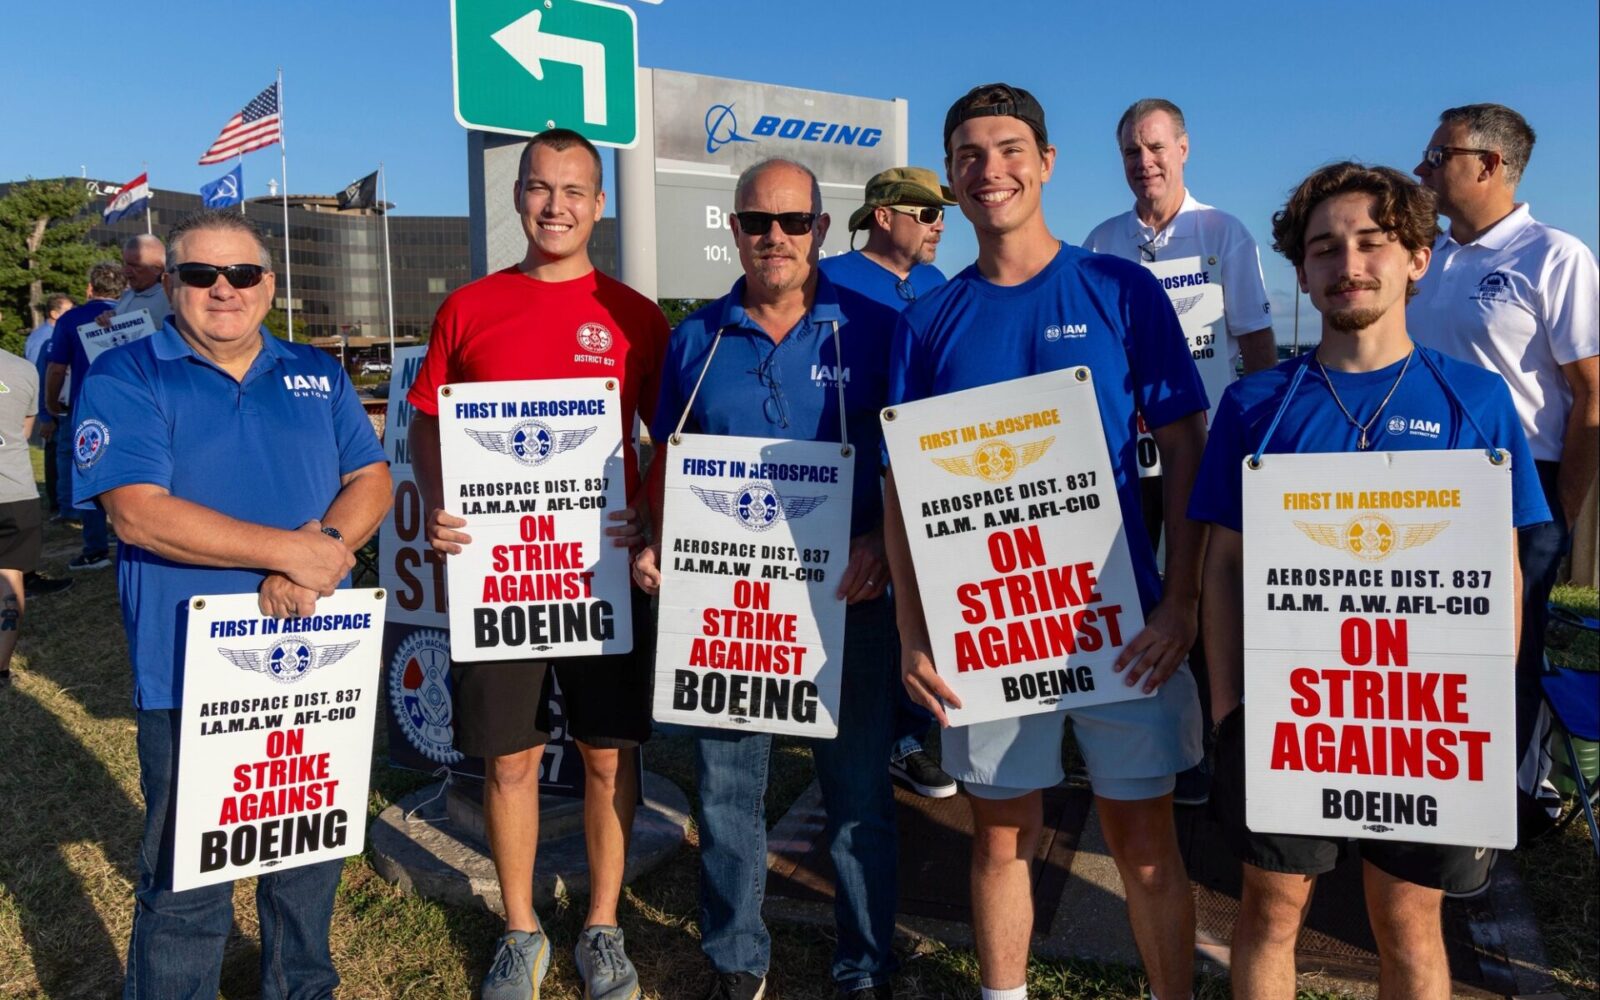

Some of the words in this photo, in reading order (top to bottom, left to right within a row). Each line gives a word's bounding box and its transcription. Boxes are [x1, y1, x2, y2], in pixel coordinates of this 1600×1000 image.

[752, 116, 882, 147] BOEING
[85, 330, 103, 339] FIRST
[111, 317, 145, 332] AEROSPACE
[1062, 324, 1087, 334] IAM
[1196, 334, 1215, 346] 837
[574, 354, 602, 364] DISTRICT
[811, 365, 850, 382] IAM
[283, 374, 331, 392] IAM
[294, 391, 328, 399] UNION
[456, 402, 499, 419] FIRST
[501, 402, 518, 417] IN
[521, 400, 605, 417] AEROSPACE
[919, 430, 959, 451] FIRST
[962, 427, 978, 442] IN
[979, 409, 1060, 439] AEROSPACE
[1410, 419, 1440, 433] IAM
[683, 458, 726, 477] FIRST
[729, 462, 744, 478] IN
[749, 463, 838, 484] AEROSPACE
[460, 480, 540, 497] AEROSPACE
[545, 479, 580, 494] DIST.
[585, 478, 609, 492] 837
[922, 486, 1014, 517] AEROSPACE
[1020, 479, 1062, 497] DIST.
[1066, 471, 1097, 490] 837
[1284, 492, 1331, 510] FIRST
[1336, 491, 1352, 509] IN
[1358, 490, 1460, 509] AEROSPACE
[462, 498, 536, 514] I.A.M.A.W
[547, 496, 607, 511] AFL-CIO
[926, 519, 976, 538] I.A.M.
[984, 510, 1025, 528] A.W.
[1028, 494, 1100, 520] AFL-CIO
[520, 515, 554, 542] ON
[492, 543, 583, 572] STRIKE
[674, 539, 756, 557] AEROSPACE
[761, 545, 797, 561] DIST.
[803, 548, 829, 563] 837
[988, 525, 1046, 573] ON
[674, 557, 750, 577] I.A.M.A.W
[761, 564, 824, 582] AFL-CIO
[1267, 569, 1383, 587] AEROSPACE
[1392, 570, 1444, 588] DIST.
[1452, 571, 1491, 588] 837
[482, 571, 594, 602] AGAINST
[734, 580, 770, 610] ON
[957, 562, 1102, 624] STRIKE
[1268, 594, 1329, 612] I.A.M.
[1339, 595, 1391, 613] A.W.
[1396, 595, 1490, 615] AFL-CIO
[210, 619, 259, 638] FIRST
[262, 618, 278, 634] IN
[282, 614, 371, 634] AEROSPACE
[474, 601, 615, 648] BOEING
[703, 608, 797, 642] STRIKE
[954, 605, 1123, 673] AGAINST
[1340, 617, 1408, 666] ON
[689, 638, 806, 675] AGAINST
[673, 669, 818, 723] BOEING
[1002, 666, 1095, 702] BOEING
[1289, 668, 1468, 724] STRIKE
[200, 695, 288, 717] AEROSPACE
[294, 692, 330, 708] DIST.
[336, 689, 361, 703] 837
[201, 715, 283, 736] I.A.M.A.W
[294, 707, 355, 725] AFL-CIO
[266, 729, 303, 758] ON
[1270, 722, 1491, 781] AGAINST
[233, 753, 330, 792] STRIKE
[219, 781, 339, 825] AGAINST
[1322, 789, 1437, 826] BOEING
[200, 809, 347, 873] BOEING
